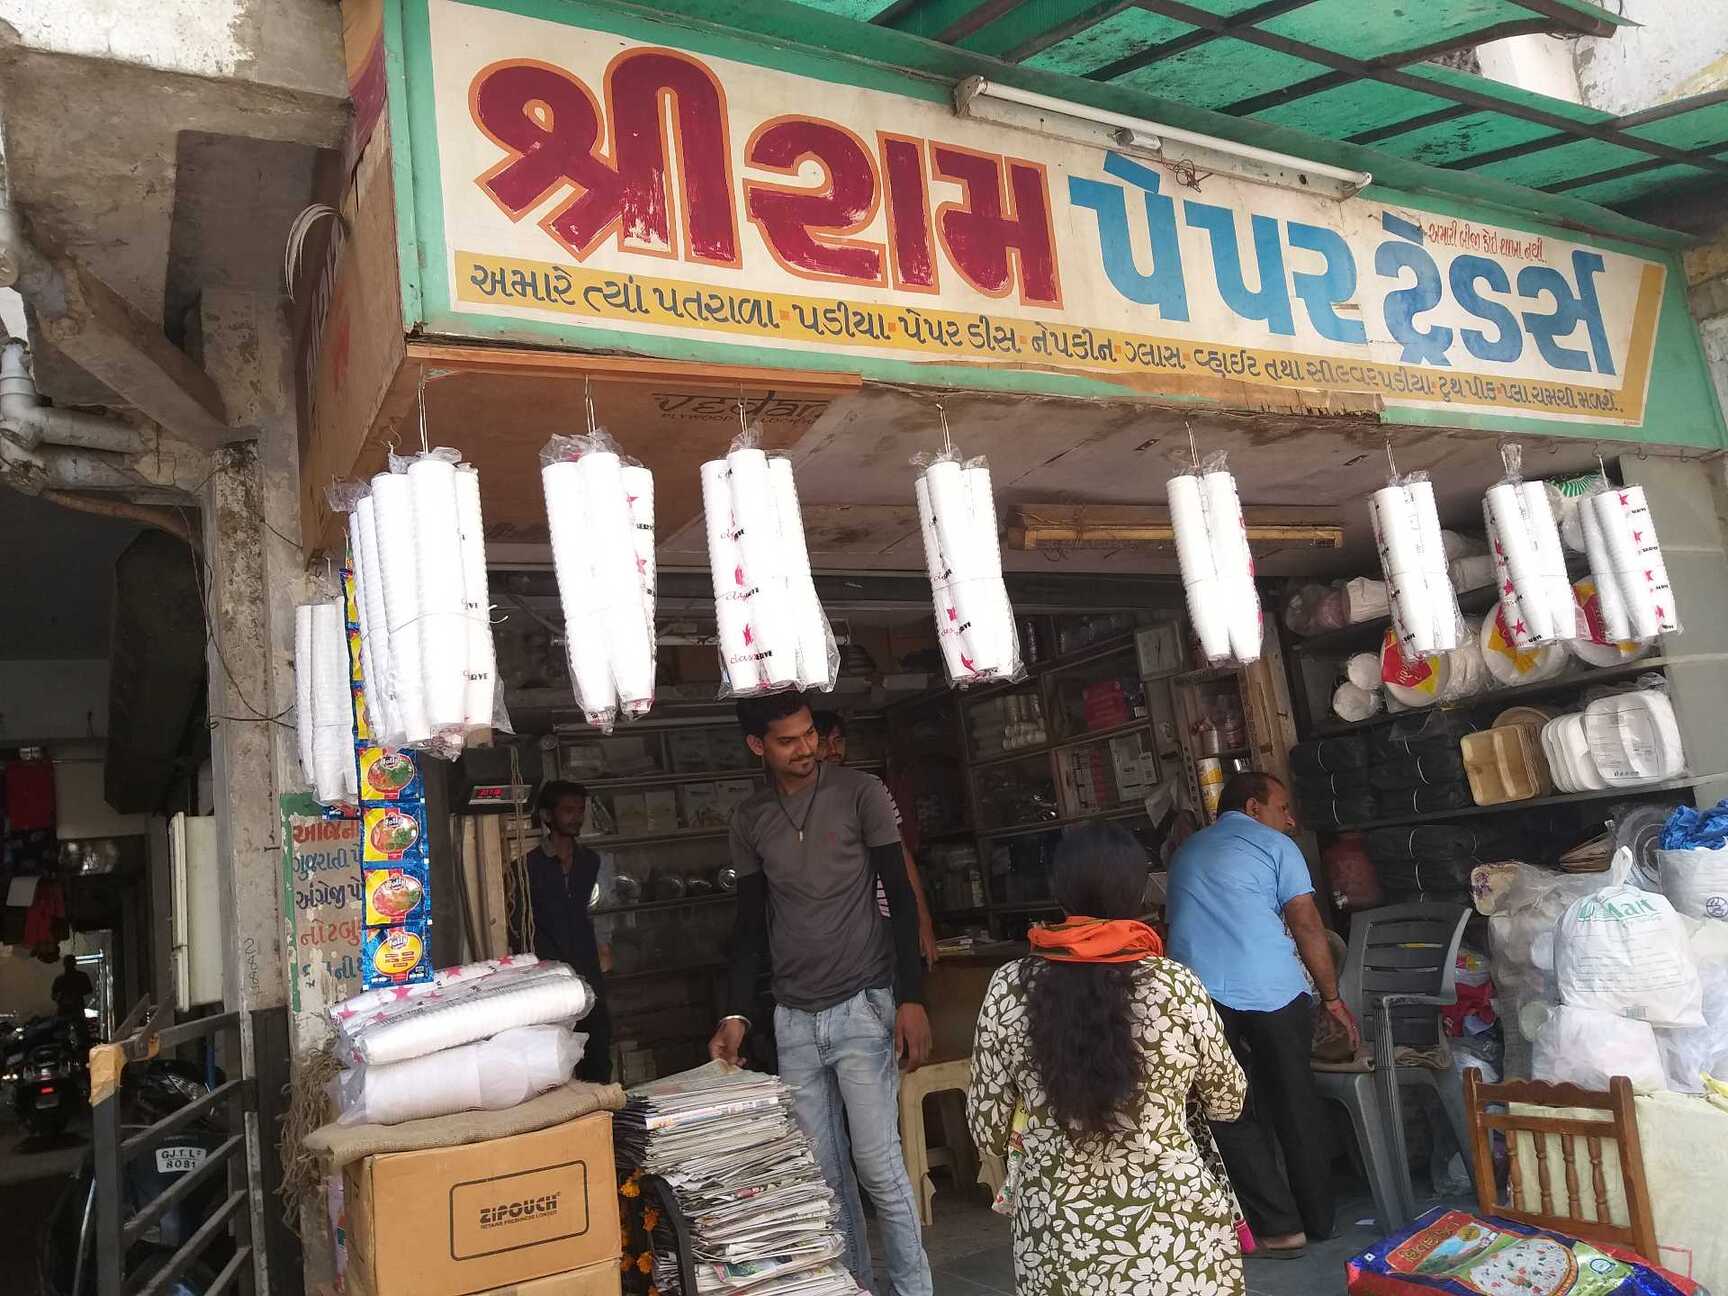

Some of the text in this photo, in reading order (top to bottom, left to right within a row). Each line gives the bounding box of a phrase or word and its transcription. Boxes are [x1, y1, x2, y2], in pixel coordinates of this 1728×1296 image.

[1068, 150, 1368, 345] પેપર
[1374, 211, 1616, 376] ટ્રેડર્સ
[1428, 219, 1457, 247] અમારી
[471, 264, 575, 306] અમારે
[583, 274, 650, 314] ત્યાં
[652, 287, 780, 329] પતરાળા
[792, 301, 891, 340] પડીયા
[898, 309, 961, 347] પેપર
[967, 321, 1022, 353] ડીસ
[1031, 320, 1117, 364] નેપકીન
[1124, 340, 1184, 369] ગ્લાસ
[1264, 359, 1304, 383] તથા
